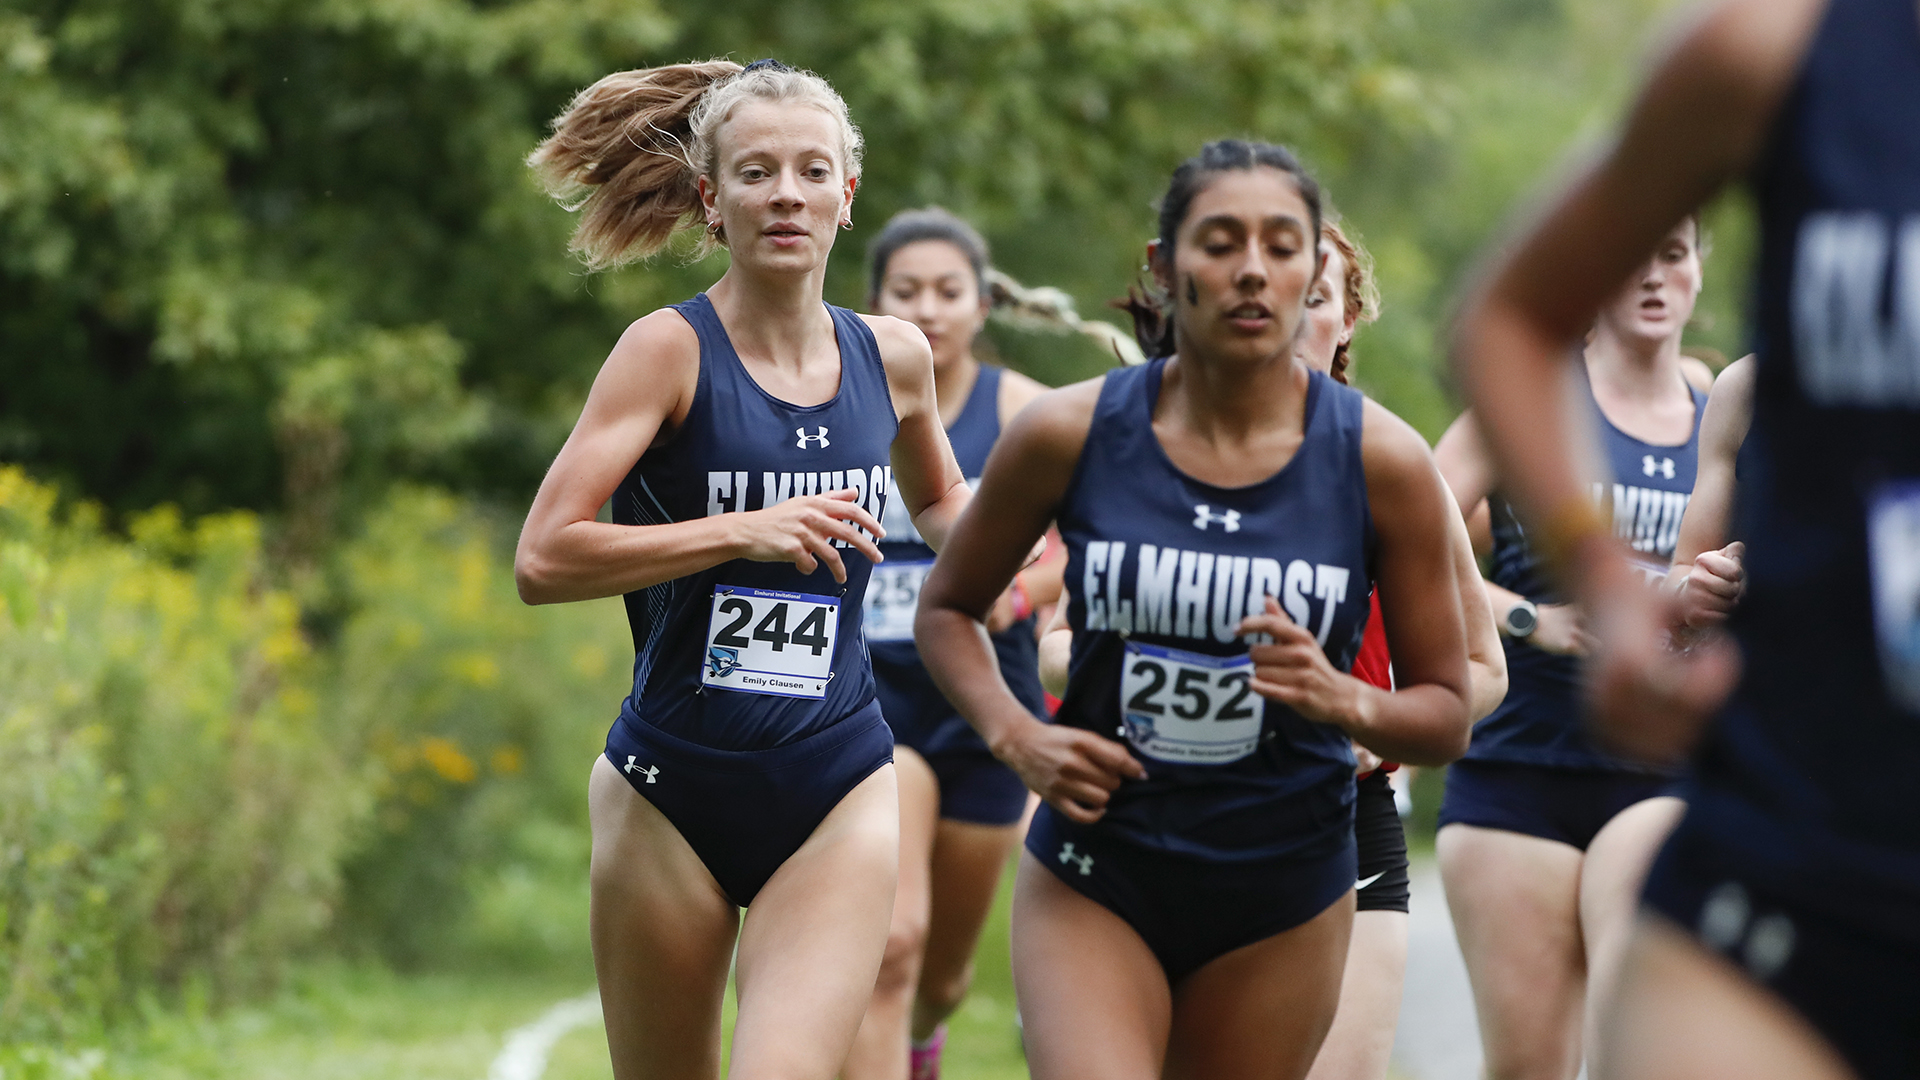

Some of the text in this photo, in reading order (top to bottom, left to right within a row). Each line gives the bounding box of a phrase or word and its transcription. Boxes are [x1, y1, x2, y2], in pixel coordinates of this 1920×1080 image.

[754, 590, 801, 600] Elmhurst Invitational
[872, 572, 916, 608] 25
[1085, 541, 1349, 647] ELMHURST
[713, 598, 828, 656] 244
[742, 676, 804, 689] Emily Clausen
[1128, 660, 1254, 722] 252
